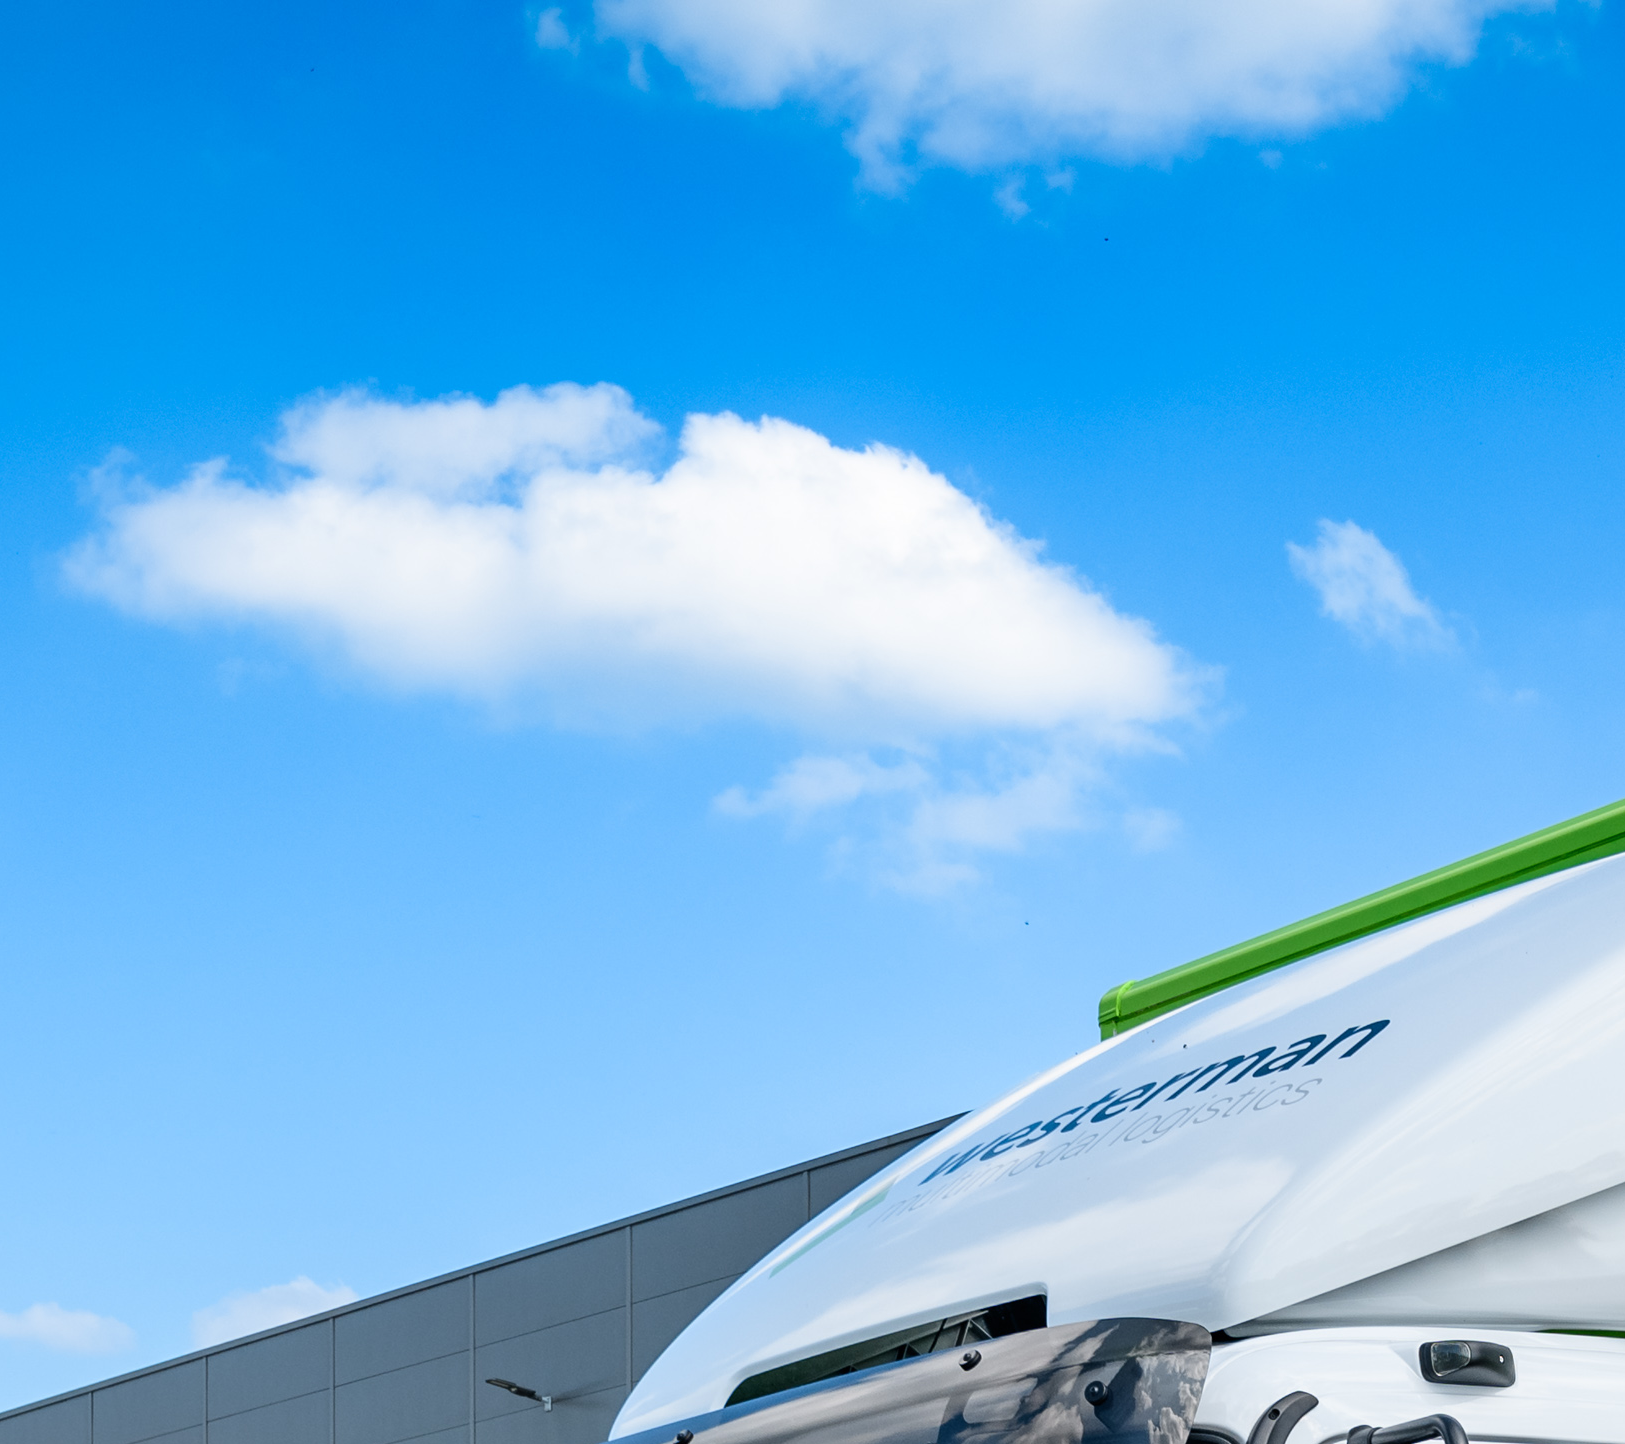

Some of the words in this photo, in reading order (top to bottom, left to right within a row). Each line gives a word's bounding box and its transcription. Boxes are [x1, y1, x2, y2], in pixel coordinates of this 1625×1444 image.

[869, 1122, 1124, 1225] multimodal
[1110, 1078, 1323, 1147] logistics
[918, 1018, 1391, 1188] westerman
